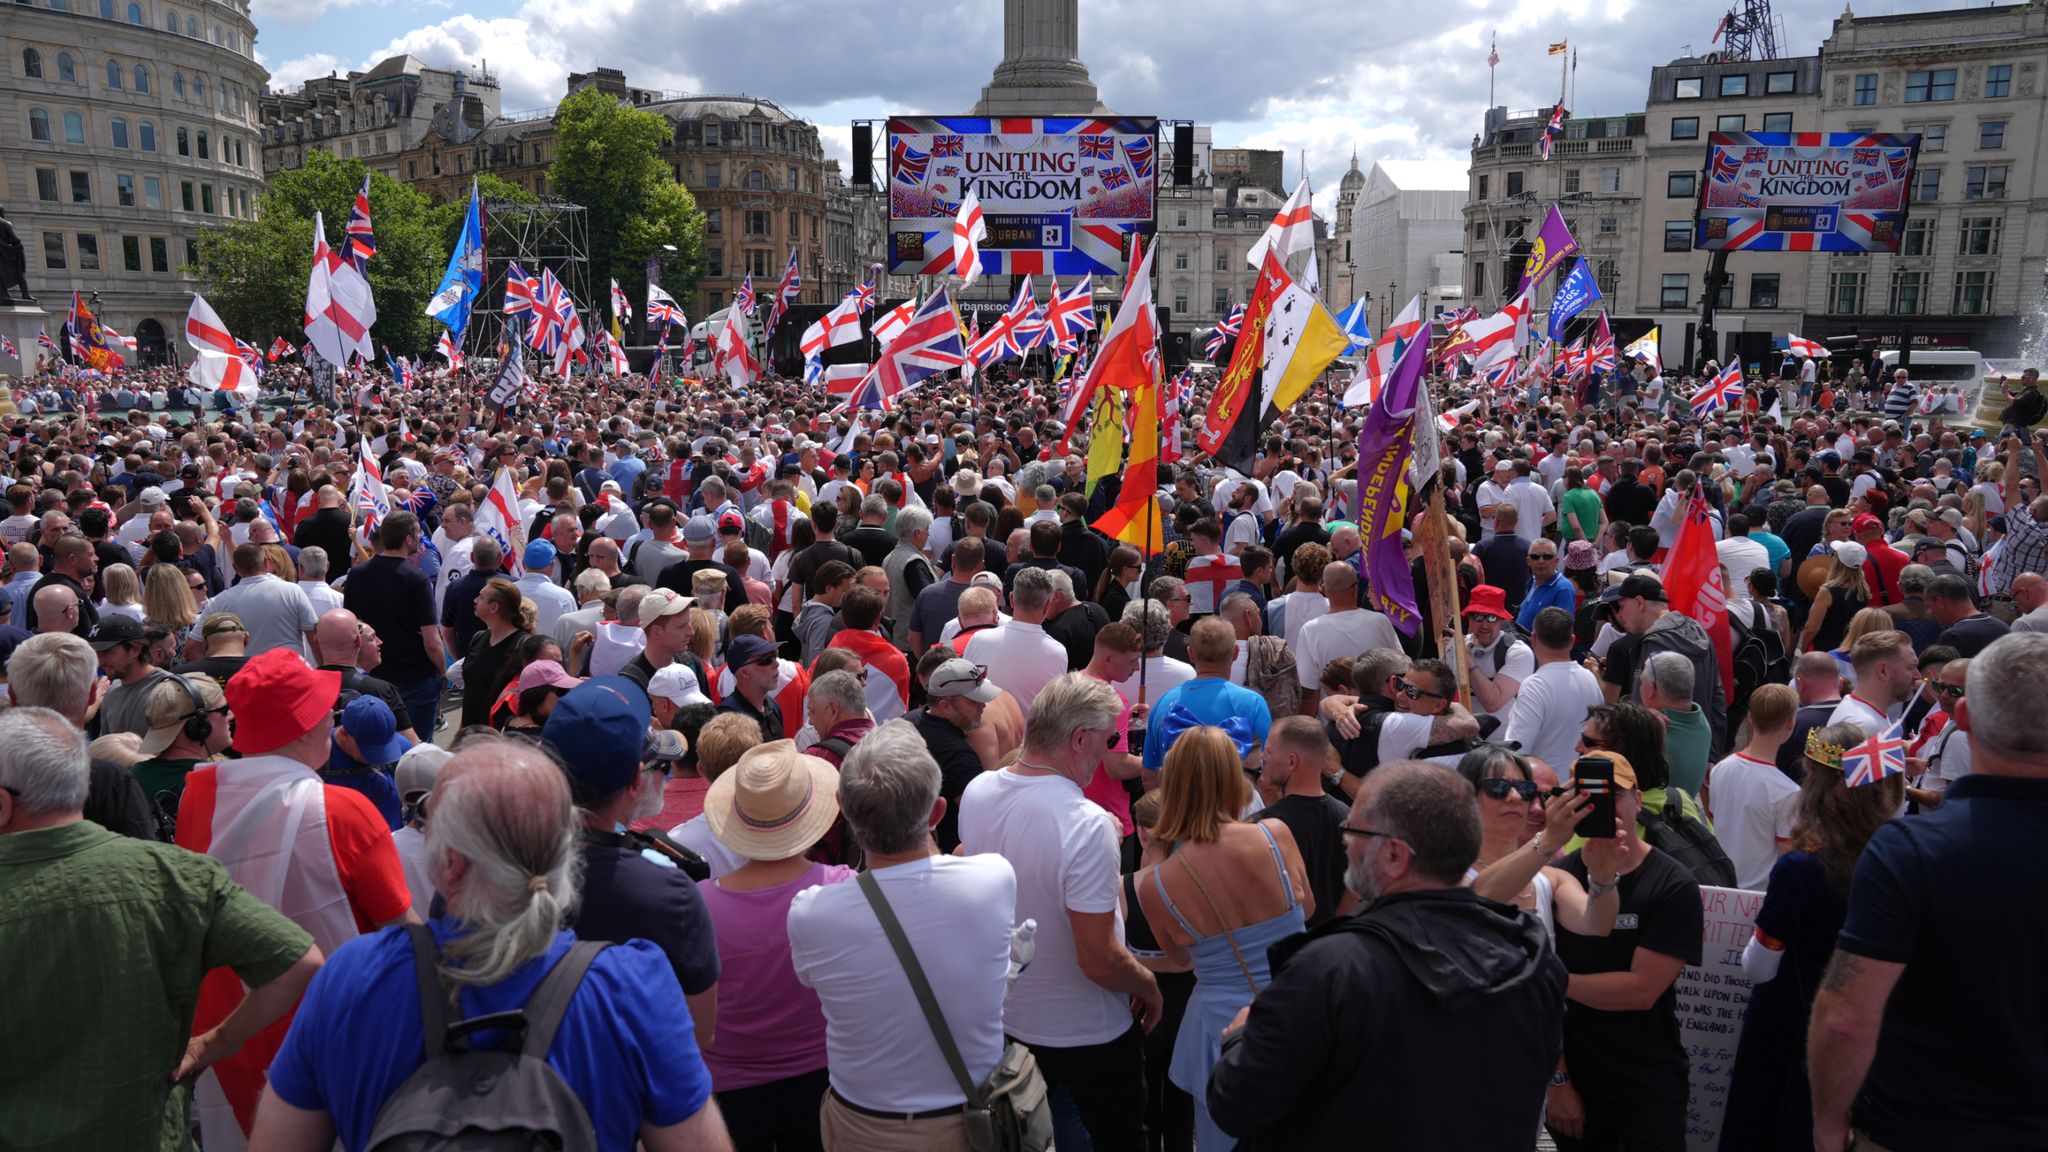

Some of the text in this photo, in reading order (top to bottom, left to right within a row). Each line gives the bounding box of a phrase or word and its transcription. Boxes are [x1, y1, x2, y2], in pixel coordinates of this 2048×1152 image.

[964, 152, 1076, 174] UNITING
[1767, 159, 1849, 176] UNITING
[1009, 172, 1031, 180] THE
[959, 177, 1082, 200] KINGDOM
[1759, 178, 1851, 196] KINGDOM
[958, 301, 1010, 311] rbanscoo
[1881, 335, 1896, 344] PRET
[1910, 335, 1929, 344] NGER
[1701, 890, 1727, 915] UR
[1703, 920, 1755, 947] RITTE
[1703, 972, 1720, 984] DID
[1724, 975, 1752, 989] THOSE
[1675, 985, 1702, 997] WALK
[1704, 988, 1731, 1002] UPON
[1676, 1001, 1691, 1013] ND
[1716, 1007, 1735, 1020] THE
